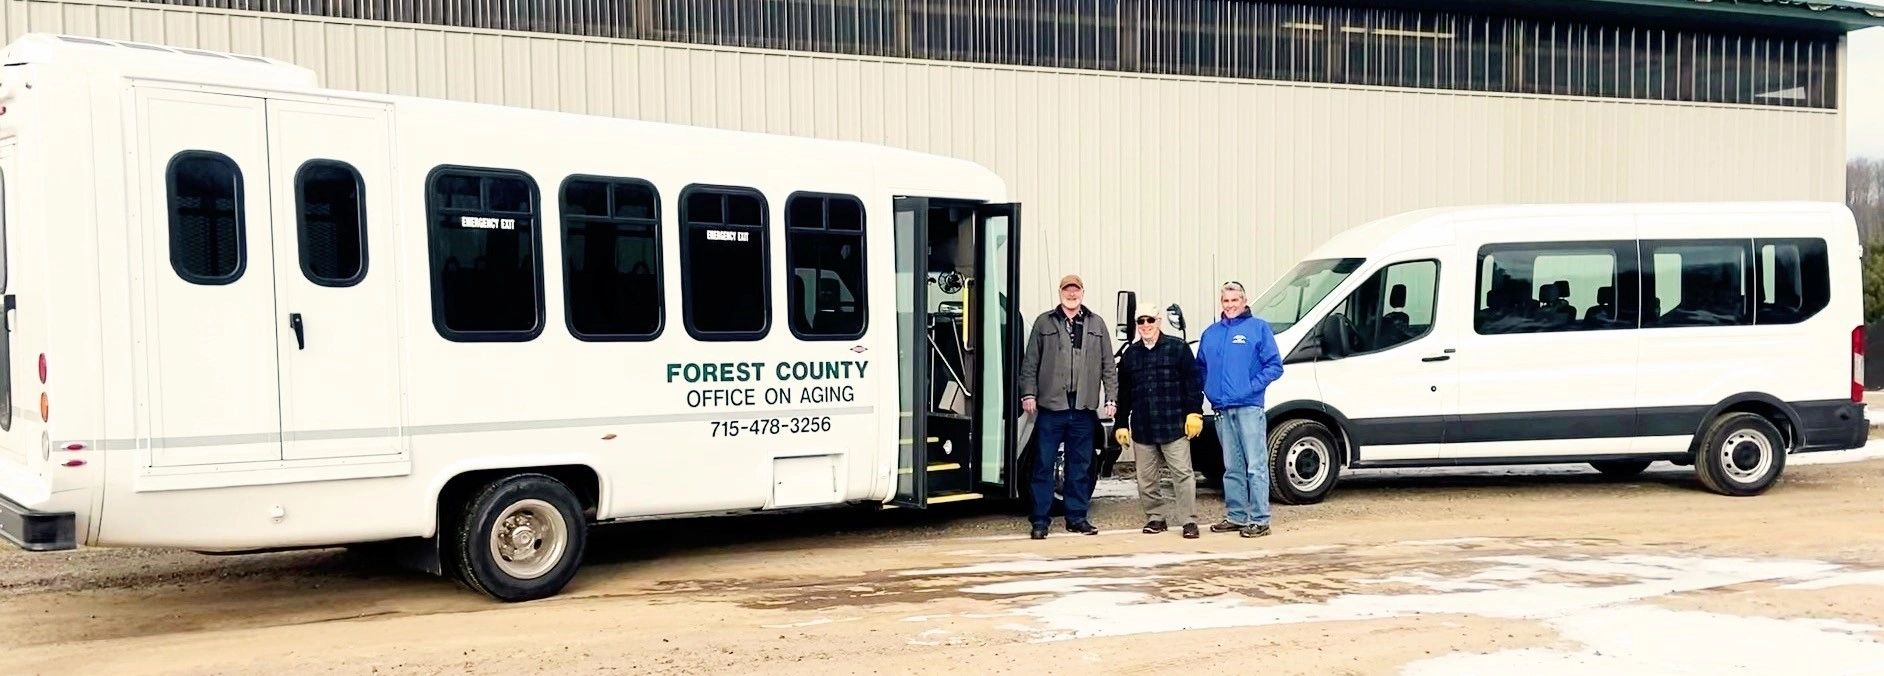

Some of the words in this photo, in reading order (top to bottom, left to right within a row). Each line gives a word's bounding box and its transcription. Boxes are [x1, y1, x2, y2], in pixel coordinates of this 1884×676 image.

[461, 216, 499, 229] EMERGENCY
[501, 218, 515, 230] EXIT
[706, 229, 736, 241] EMERGENCY
[737, 231, 749, 242] EXIT
[666, 362, 765, 383] FOREST
[775, 360, 869, 381] COUNTY
[686, 388, 756, 408] OFFICE
[764, 387, 792, 405] ON
[800, 385, 855, 404] AGING
[710, 416, 832, 437] 715-478-3256
